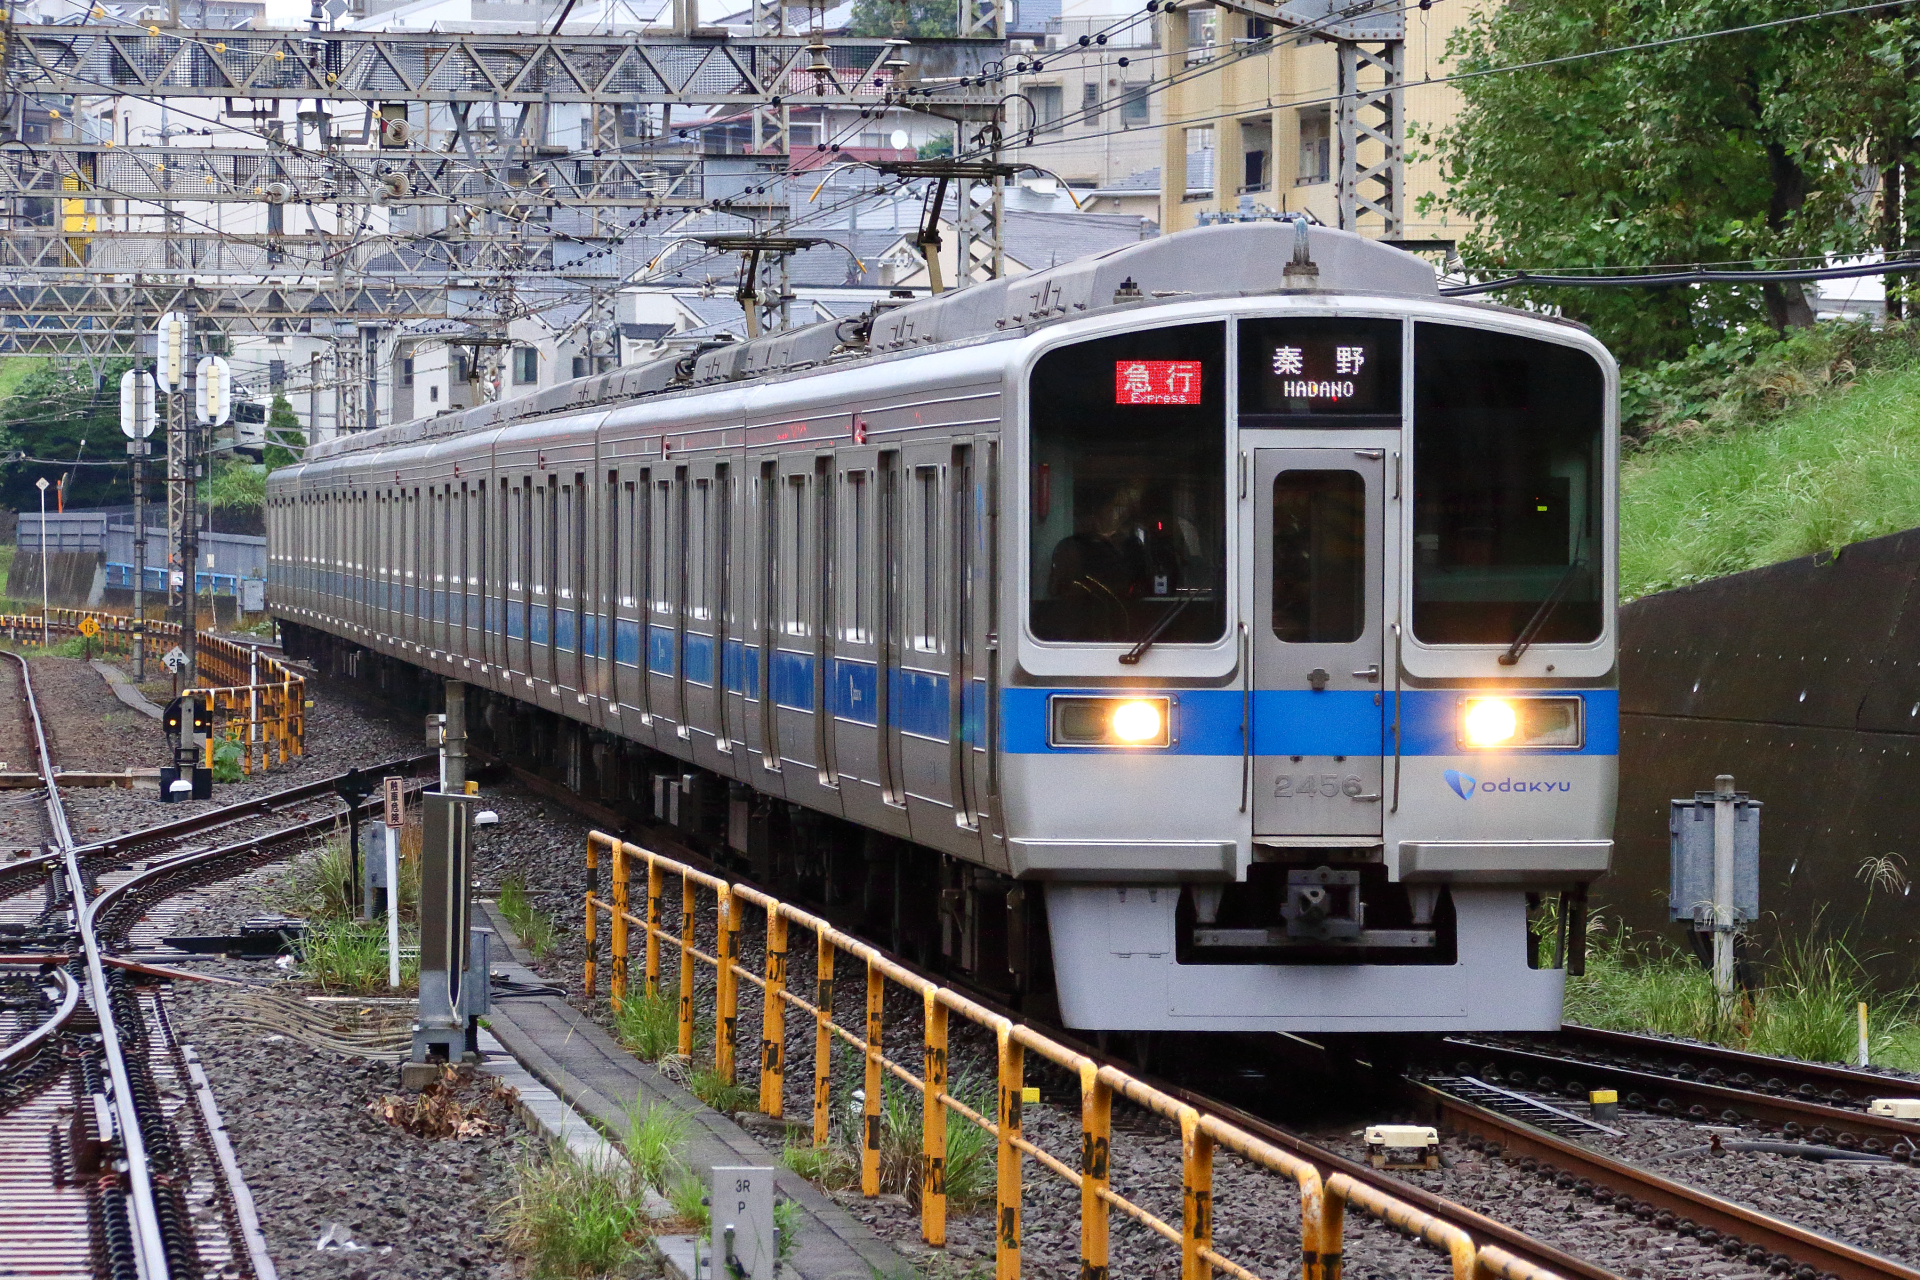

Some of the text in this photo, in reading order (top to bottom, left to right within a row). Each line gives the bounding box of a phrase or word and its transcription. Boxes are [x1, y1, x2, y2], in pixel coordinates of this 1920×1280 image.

[1272, 345, 1365, 375] 秦野
[1123, 363, 1194, 393] 急行
[1283, 380, 1354, 398] HADANO
[1131, 392, 1188, 403] Express
[85, 624, 94, 633] 15
[1273, 773, 1363, 798] 2456
[1481, 777, 1571, 793] odakyu
[735, 1179, 751, 1193] 3R
[738, 1201, 746, 1215] P
